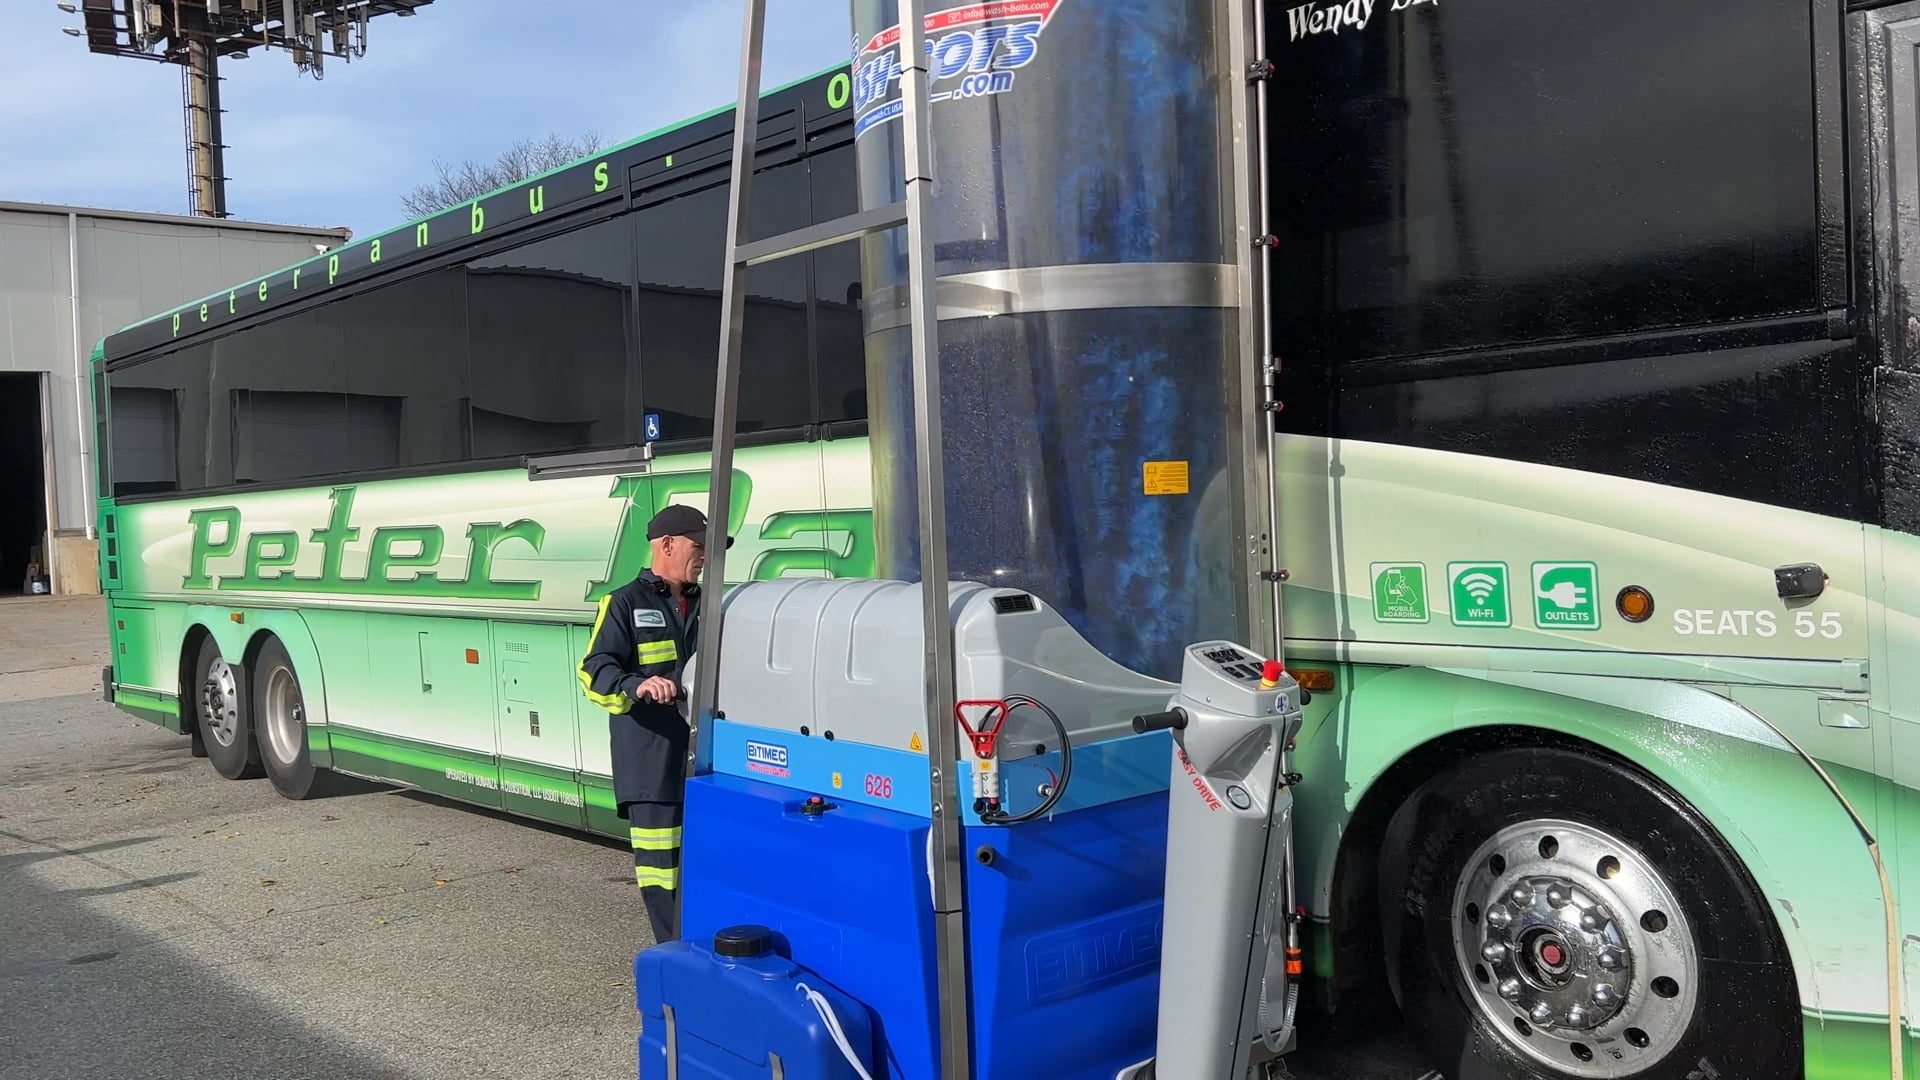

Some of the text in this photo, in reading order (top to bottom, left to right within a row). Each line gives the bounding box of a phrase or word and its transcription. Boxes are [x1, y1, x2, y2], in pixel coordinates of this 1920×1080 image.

[1286, 0, 1375, 42] Wendy
[953, 71, 1014, 100] .com
[182, 485, 546, 600] Peter
[1545, 612, 1590, 621] OUTLETS
[1673, 609, 1843, 639] SEATS 55
[865, 774, 892, 799] 626
[1177, 749, 1221, 811] EASY DRIVE
